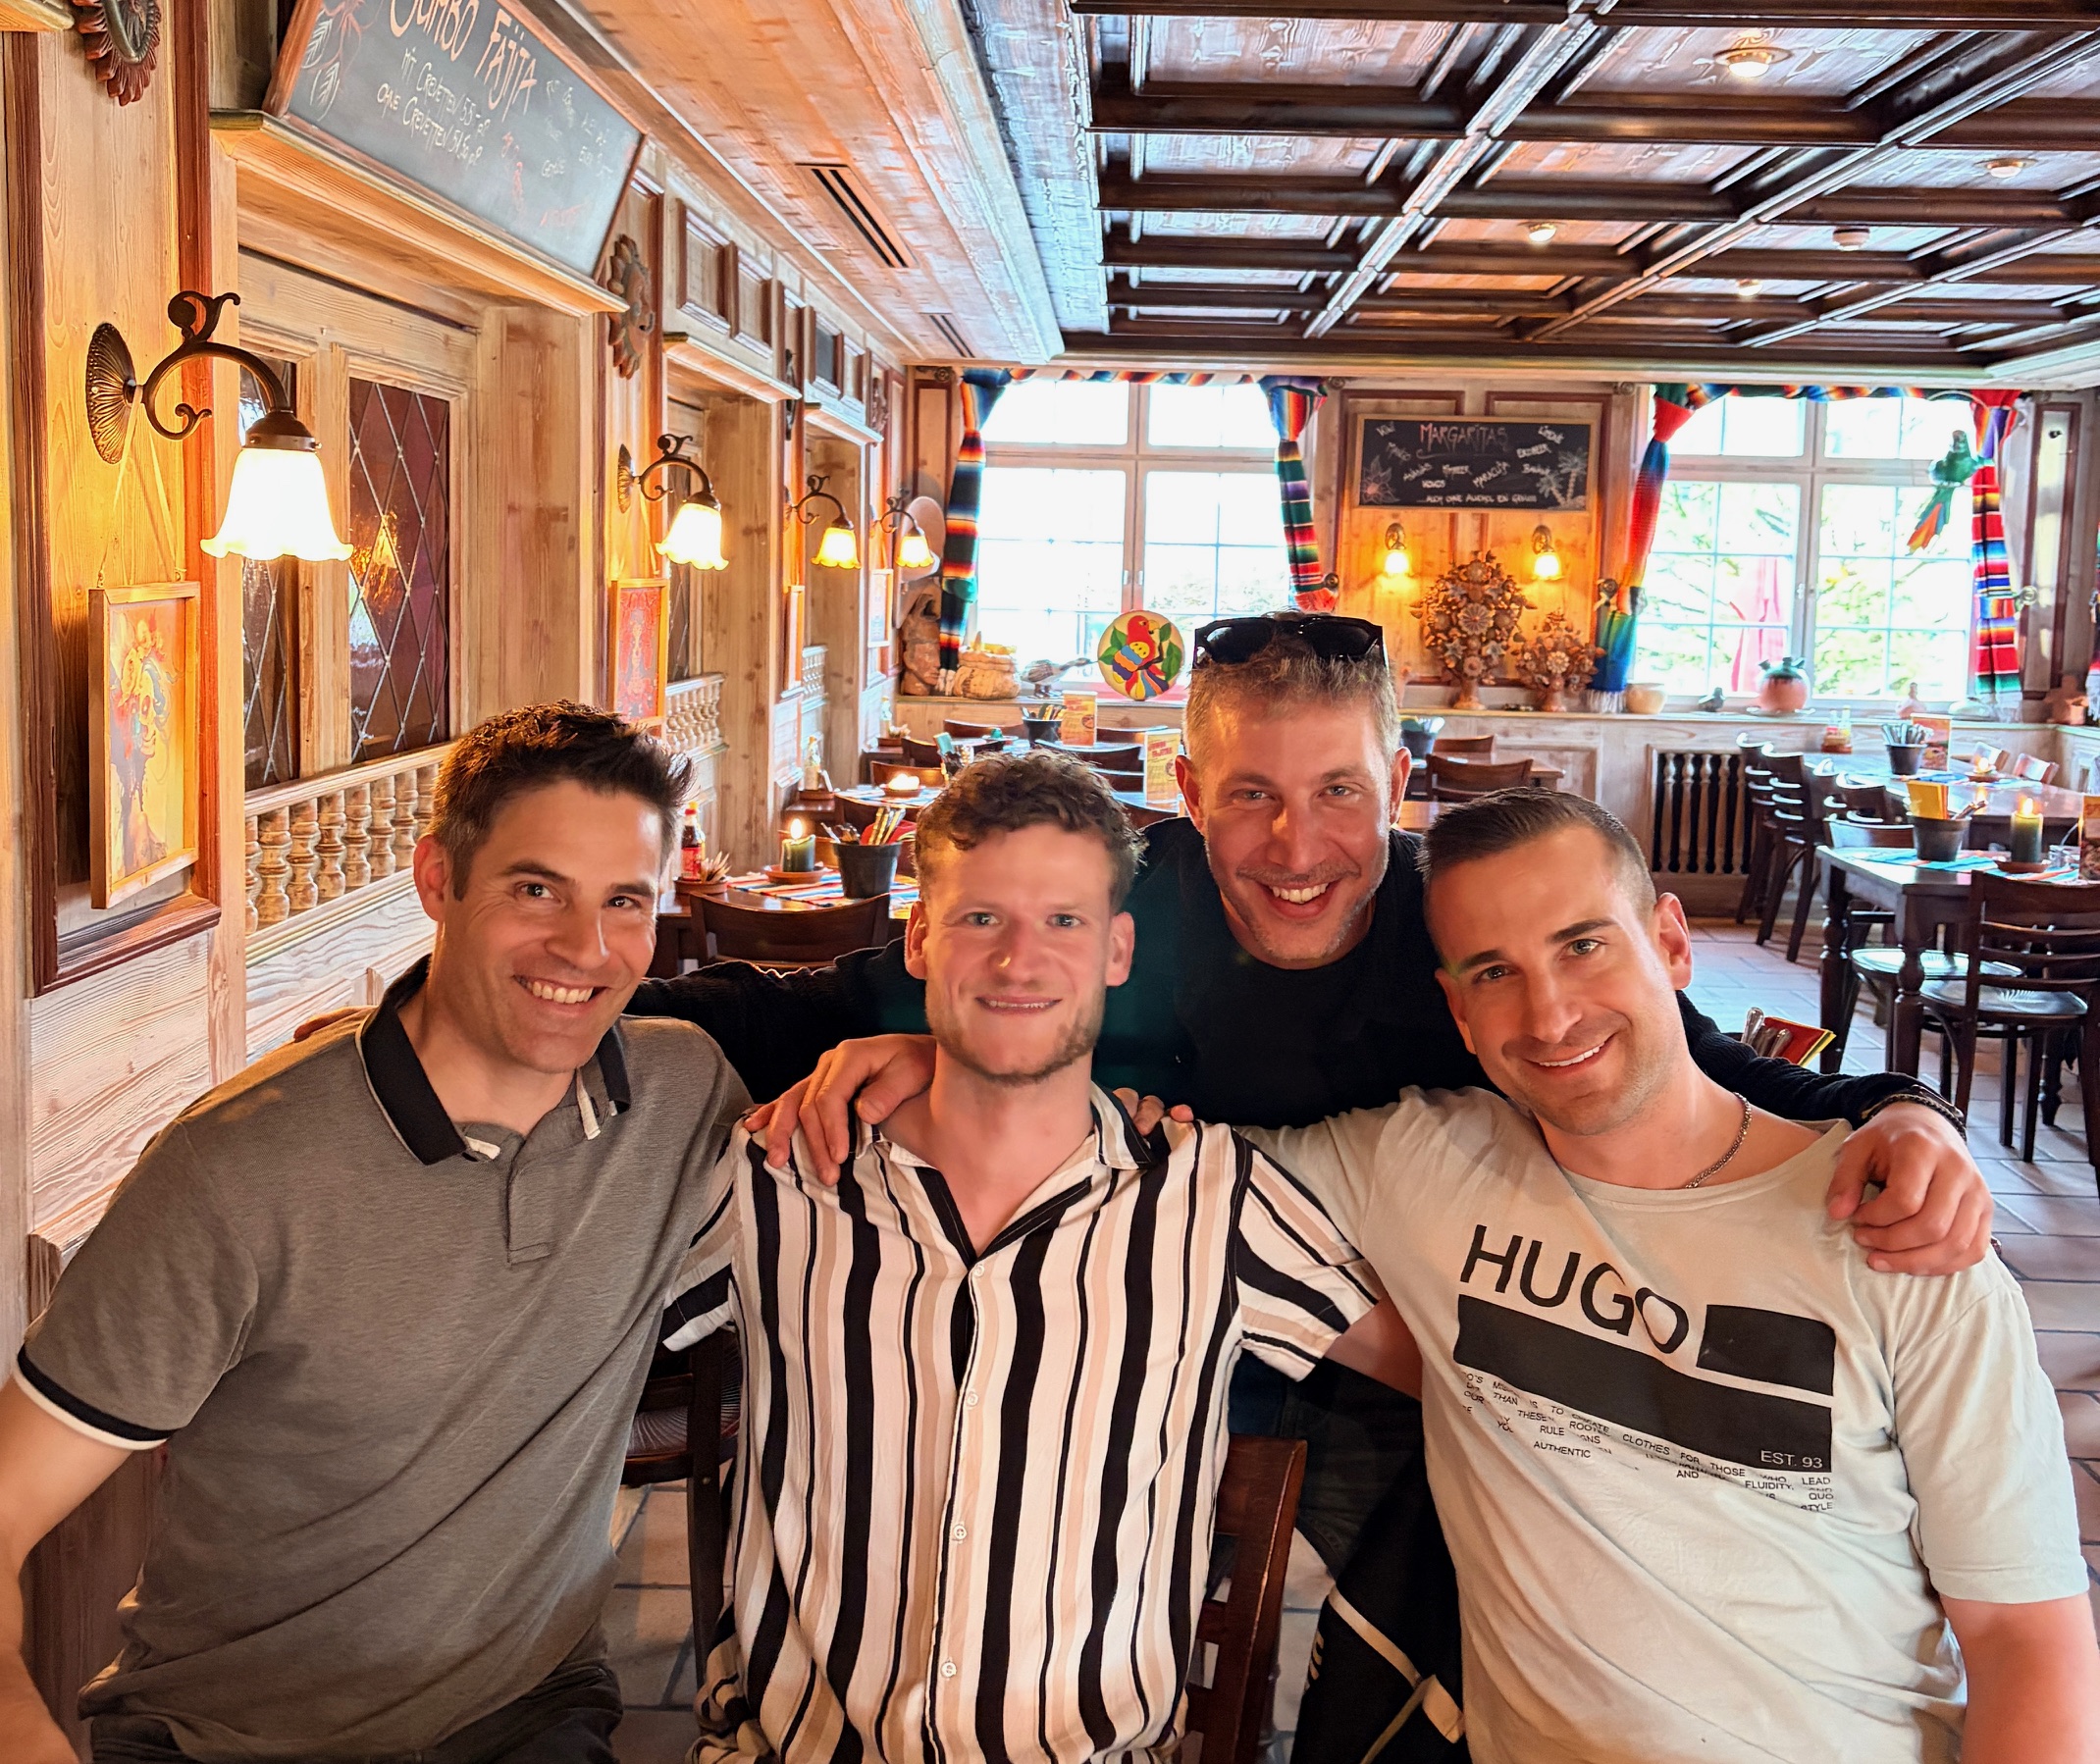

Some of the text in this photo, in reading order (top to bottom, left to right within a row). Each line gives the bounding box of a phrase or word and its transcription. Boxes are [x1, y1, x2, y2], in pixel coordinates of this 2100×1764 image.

[1419, 422, 1509, 452] MARGARITAS
[1459, 1224, 1690, 1354] HUGO
[1493, 1391, 1518, 1406] THAN
[1676, 1470, 1700, 1479] AND
[1540, 1425, 1565, 1436] RULE
[1550, 1405, 1564, 1416] TO
[1622, 1433, 1671, 1456] CLOTHES
[1680, 1452, 1701, 1465] FOR
[1709, 1462, 1746, 1478] THOSE
[1801, 1477, 1831, 1486] LEAD
[1533, 1440, 1592, 1459] AUTHENTIC
[1760, 1449, 1823, 1469] EST. 93
